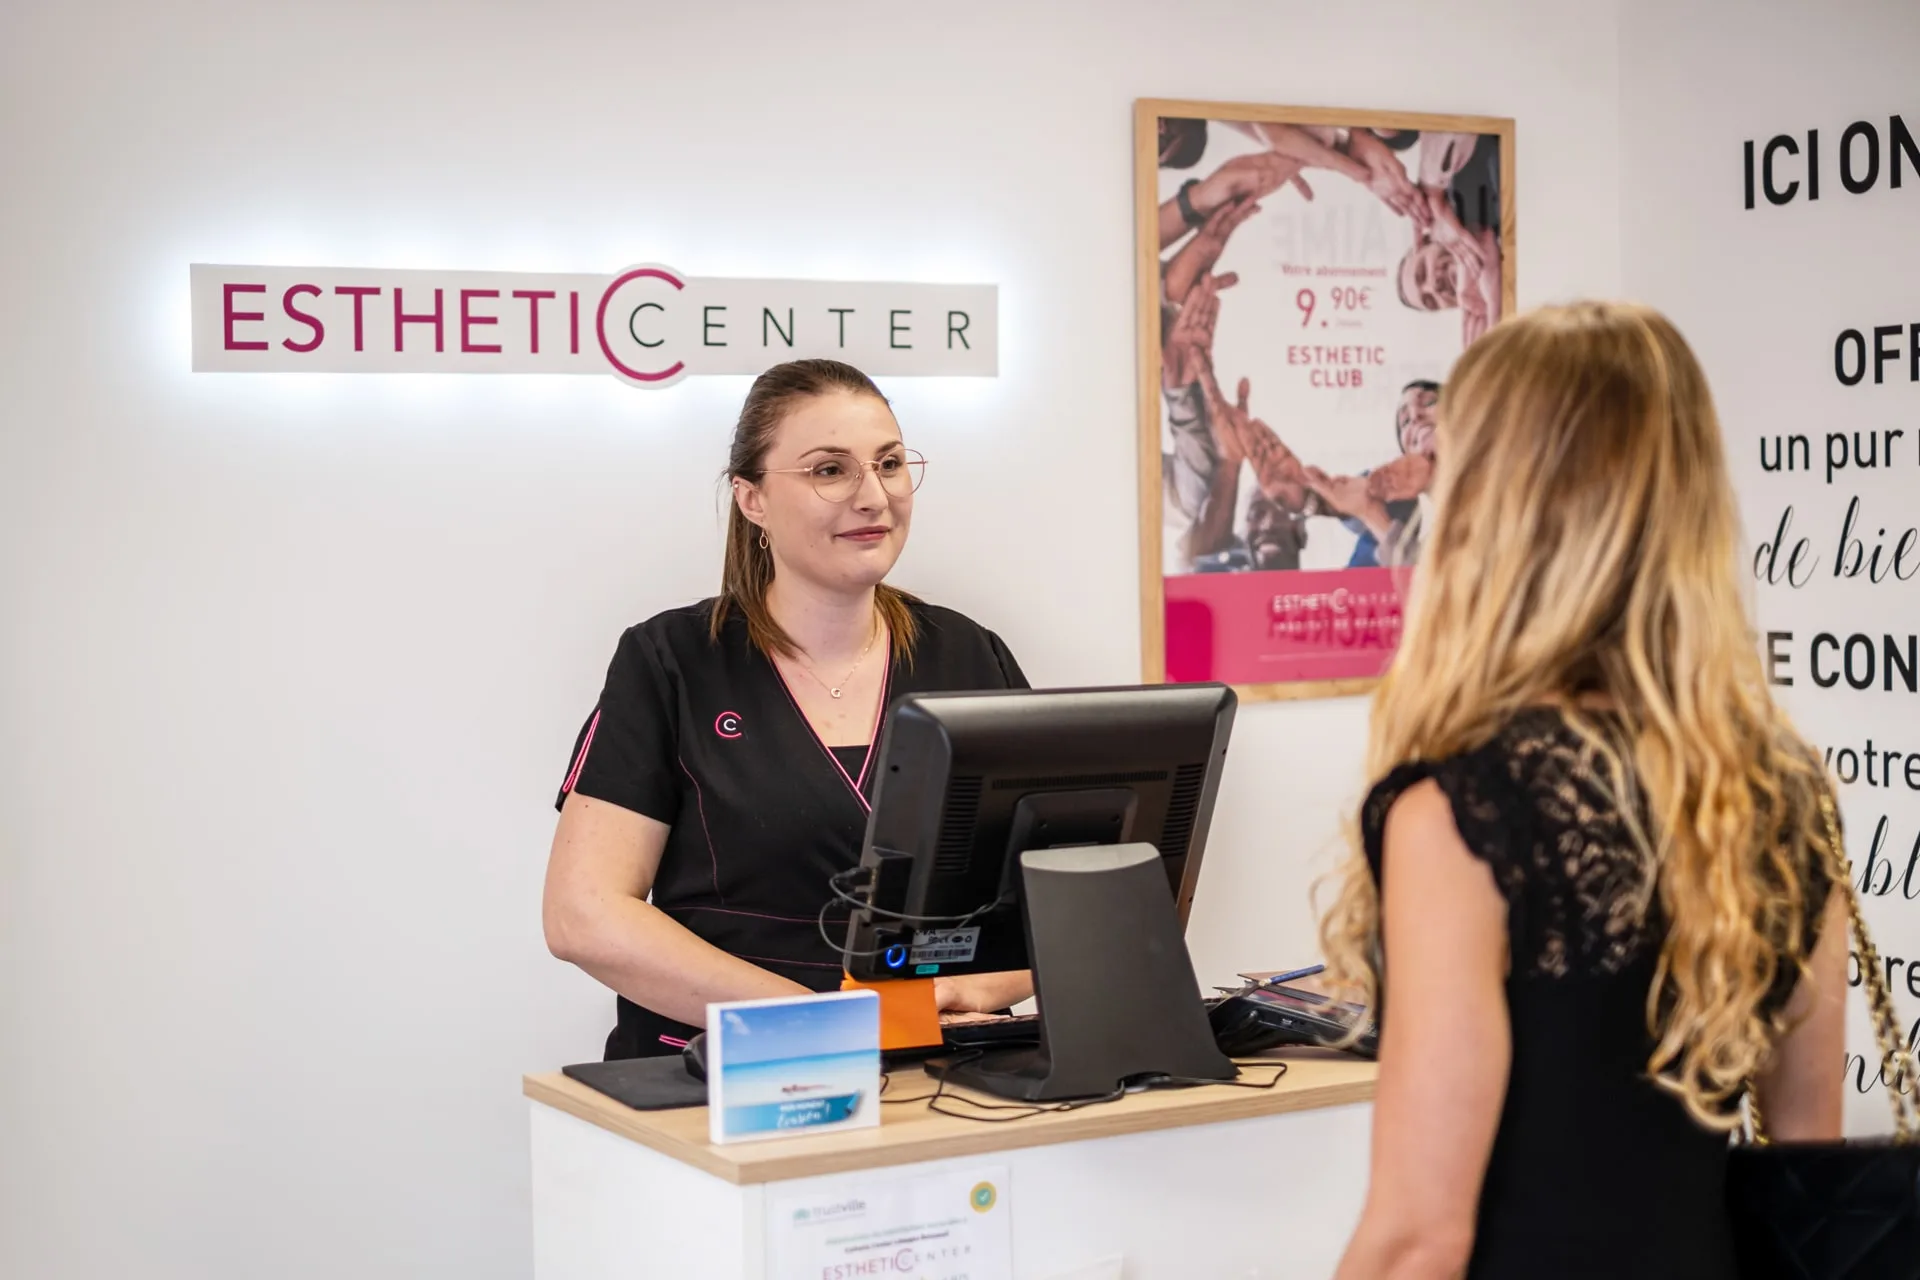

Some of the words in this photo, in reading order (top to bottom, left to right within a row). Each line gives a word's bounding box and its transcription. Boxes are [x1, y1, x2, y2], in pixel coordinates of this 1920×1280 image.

[1744, 129, 1819, 210] ICI
[1839, 115, 1920, 195] ON
[1287, 345, 1385, 366] ESTHETIC
[1310, 368, 1363, 388] CLUB
[1760, 434, 1810, 472] un
[1826, 429, 1904, 484] pur
[1753, 504, 1820, 589] de
[1833, 495, 1920, 585] bie
[1810, 632, 1918, 693] CON
